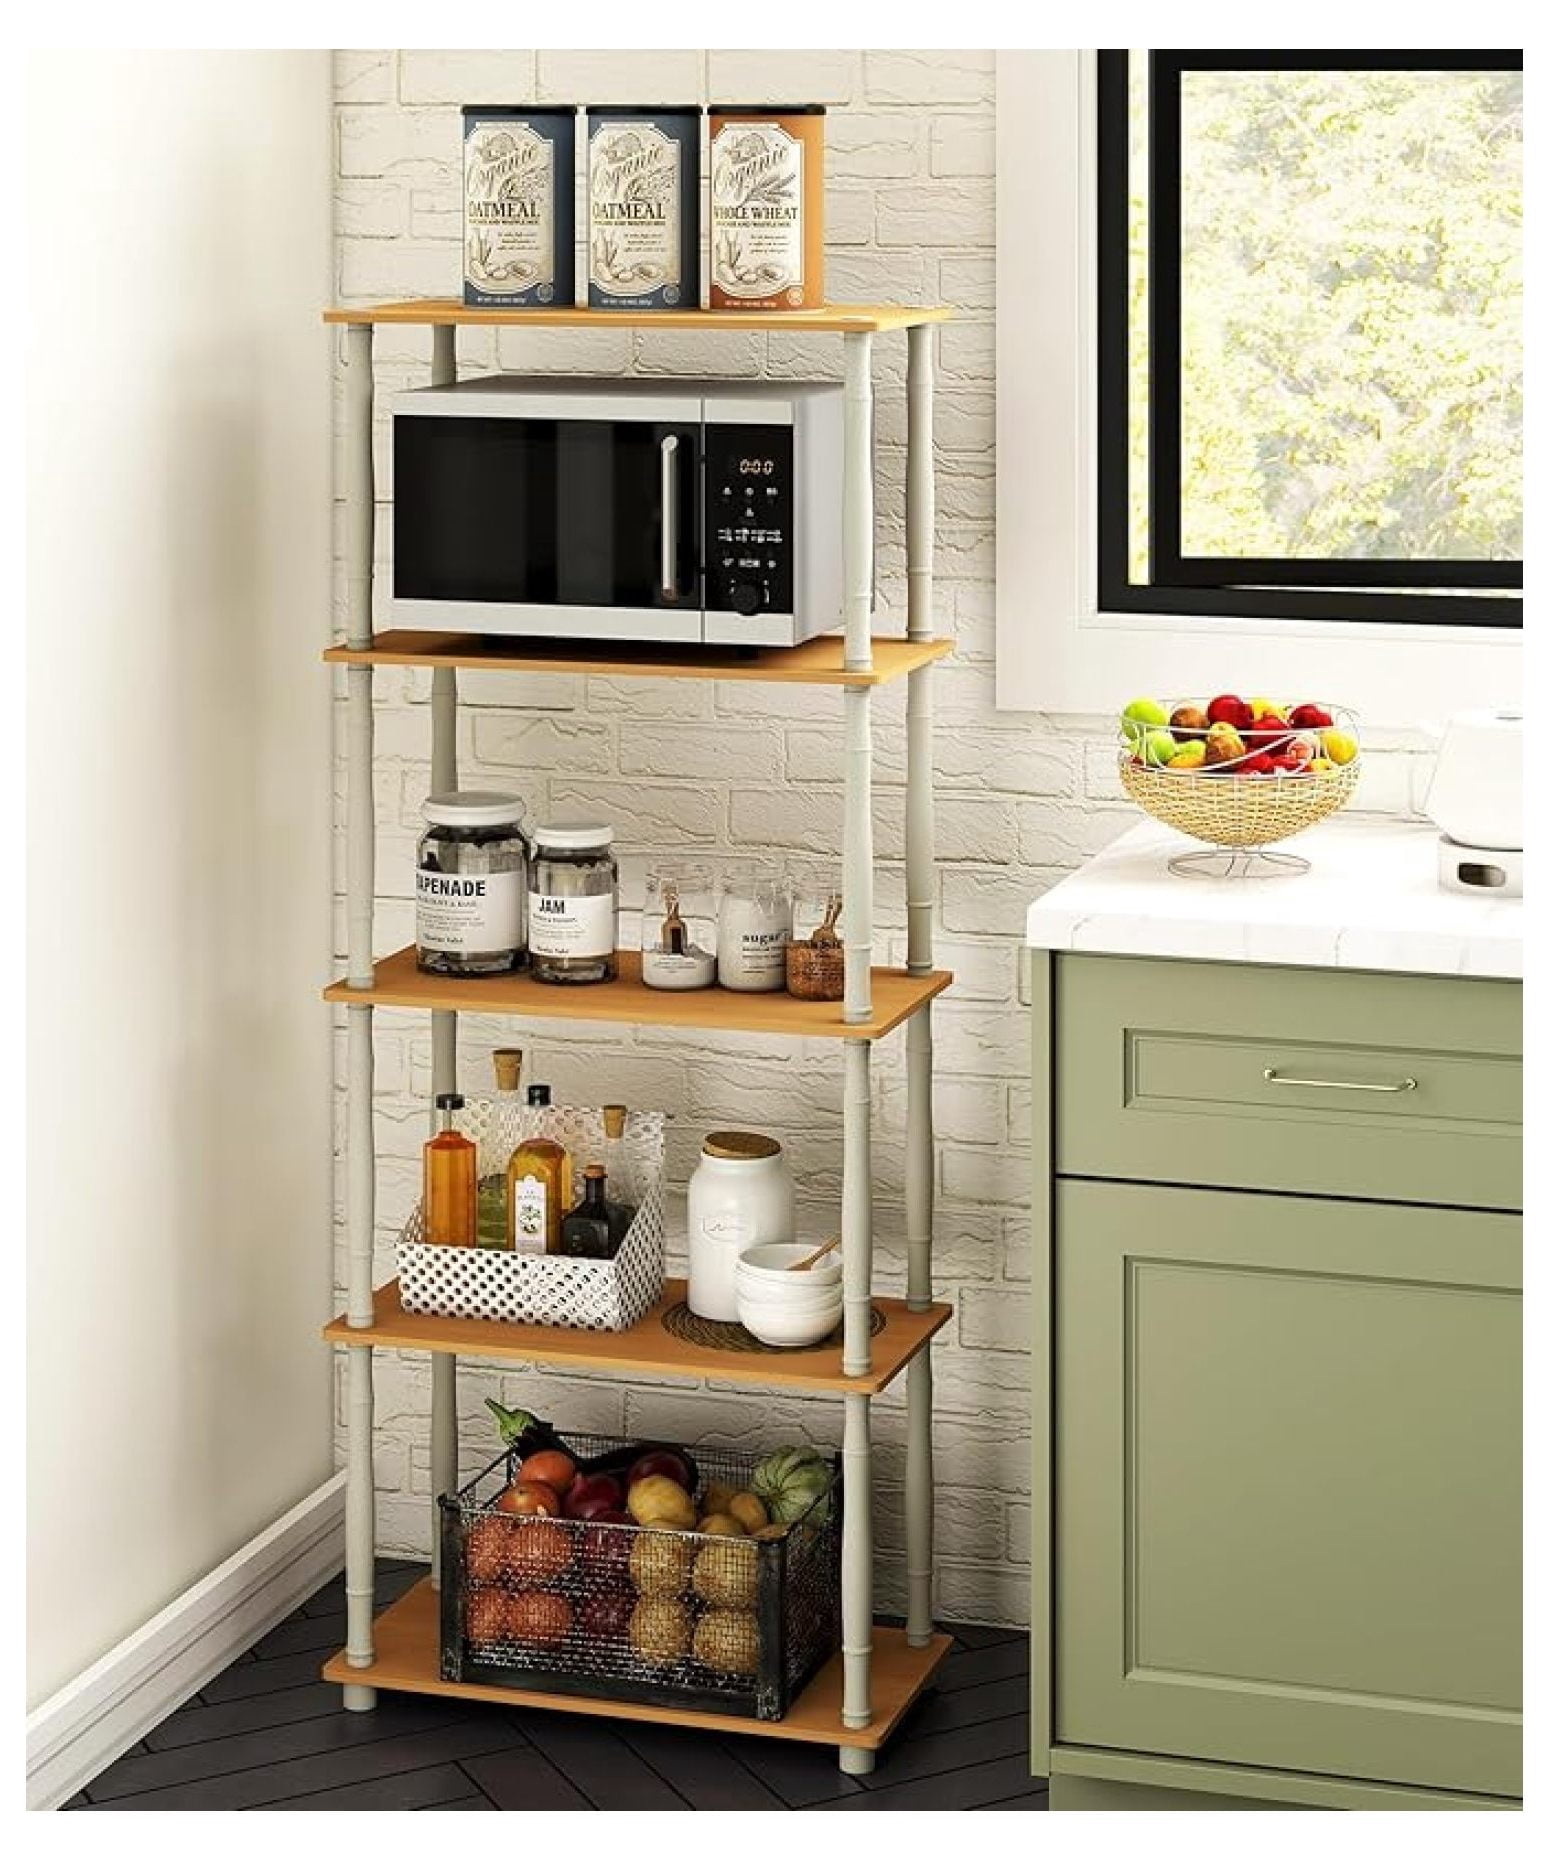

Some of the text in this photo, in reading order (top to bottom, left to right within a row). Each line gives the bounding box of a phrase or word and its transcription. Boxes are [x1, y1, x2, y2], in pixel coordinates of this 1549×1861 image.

[468, 200, 541, 217] OATMEAL
[592, 202, 666, 219] OATMEAL
[713, 205, 798, 220] WHOLE WHEAT
[416, 874, 486, 897] APENADE
[539, 897, 565, 914] JAM
[742, 932, 782, 945] sugar
